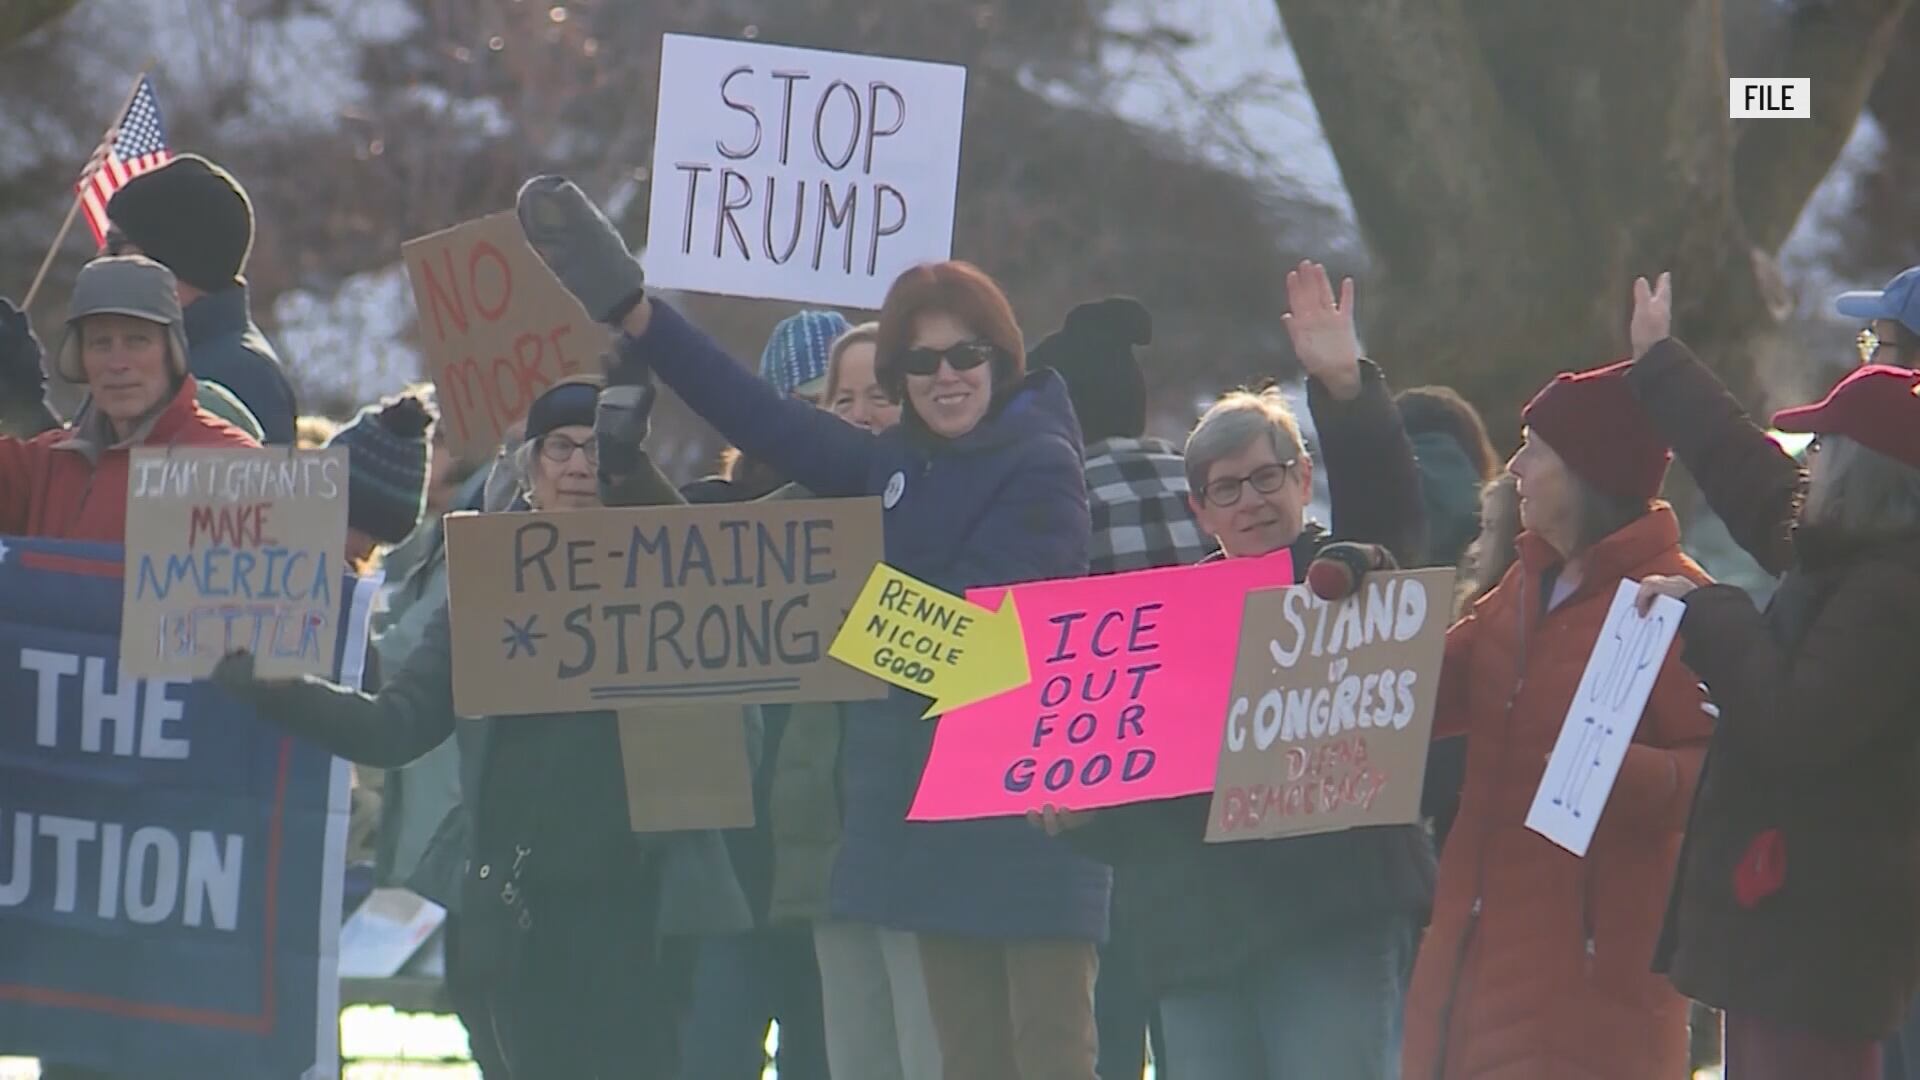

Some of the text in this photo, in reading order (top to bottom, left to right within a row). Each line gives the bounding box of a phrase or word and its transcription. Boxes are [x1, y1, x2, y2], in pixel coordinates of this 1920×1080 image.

[716, 65, 906, 174] STOP
[675, 162, 908, 276] TRUMP
[422, 240, 513, 342] NO
[445, 324, 579, 442] MORE
[188, 501, 279, 550] MAKE
[514, 518, 837, 593] RE-MAINE
[136, 547, 330, 607] AMERICA
[878, 578, 975, 637] RENNE
[557, 593, 821, 679] STRONG
[865, 613, 965, 666] NICOLE
[1045, 603, 1163, 663] ICE
[1269, 578, 1427, 669] STAND
[873, 647, 936, 684] GOOD
[1040, 663, 1162, 708] OUT
[20, 648, 193, 760] THE
[1032, 704, 1145, 748] FOR
[1227, 668, 1418, 753] CONGRESS
[1003, 748, 1156, 793] GOOD
